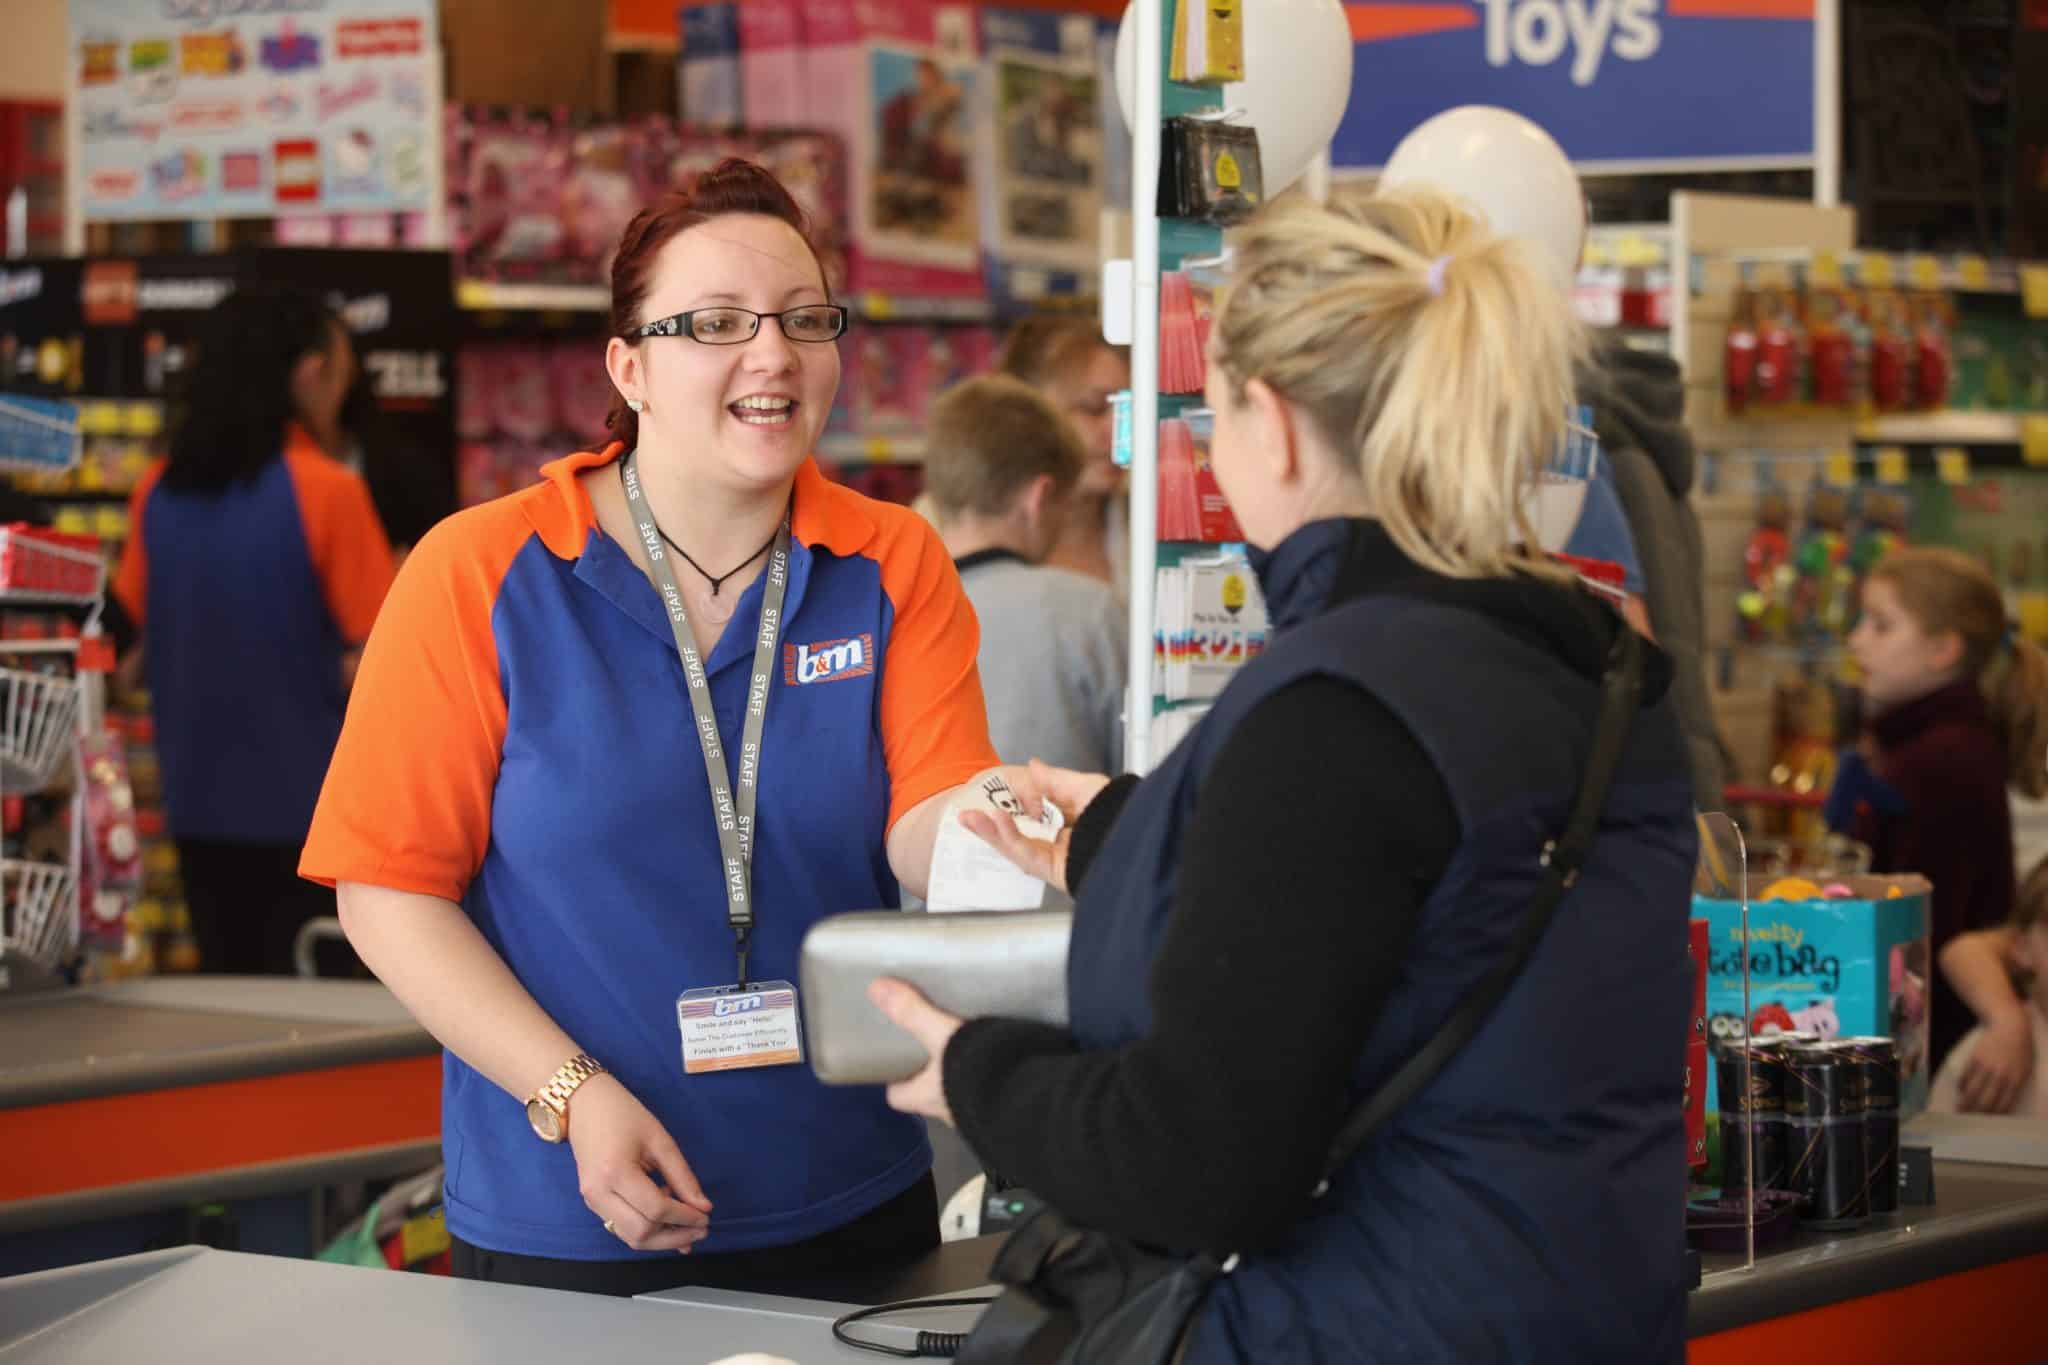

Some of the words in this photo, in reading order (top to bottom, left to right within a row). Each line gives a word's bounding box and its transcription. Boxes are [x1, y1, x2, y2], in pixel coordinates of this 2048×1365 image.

[1473, 0, 1662, 87] Toys
[625, 467, 640, 500] STAFF
[640, 522, 663, 561] STAFF
[771, 550, 785, 586] STAFF
[664, 583, 685, 622] STAFF
[762, 608, 777, 649] STAFF
[683, 647, 704, 688] STAFF
[751, 674, 766, 716] STAFF
[700, 714, 720, 759] STAFF
[743, 743, 756, 787] STAFF
[715, 786, 734, 830] STAFF
[737, 815, 750, 860] STAFF
[728, 857, 744, 902] STAFF
[1775, 942, 1840, 994] bag
